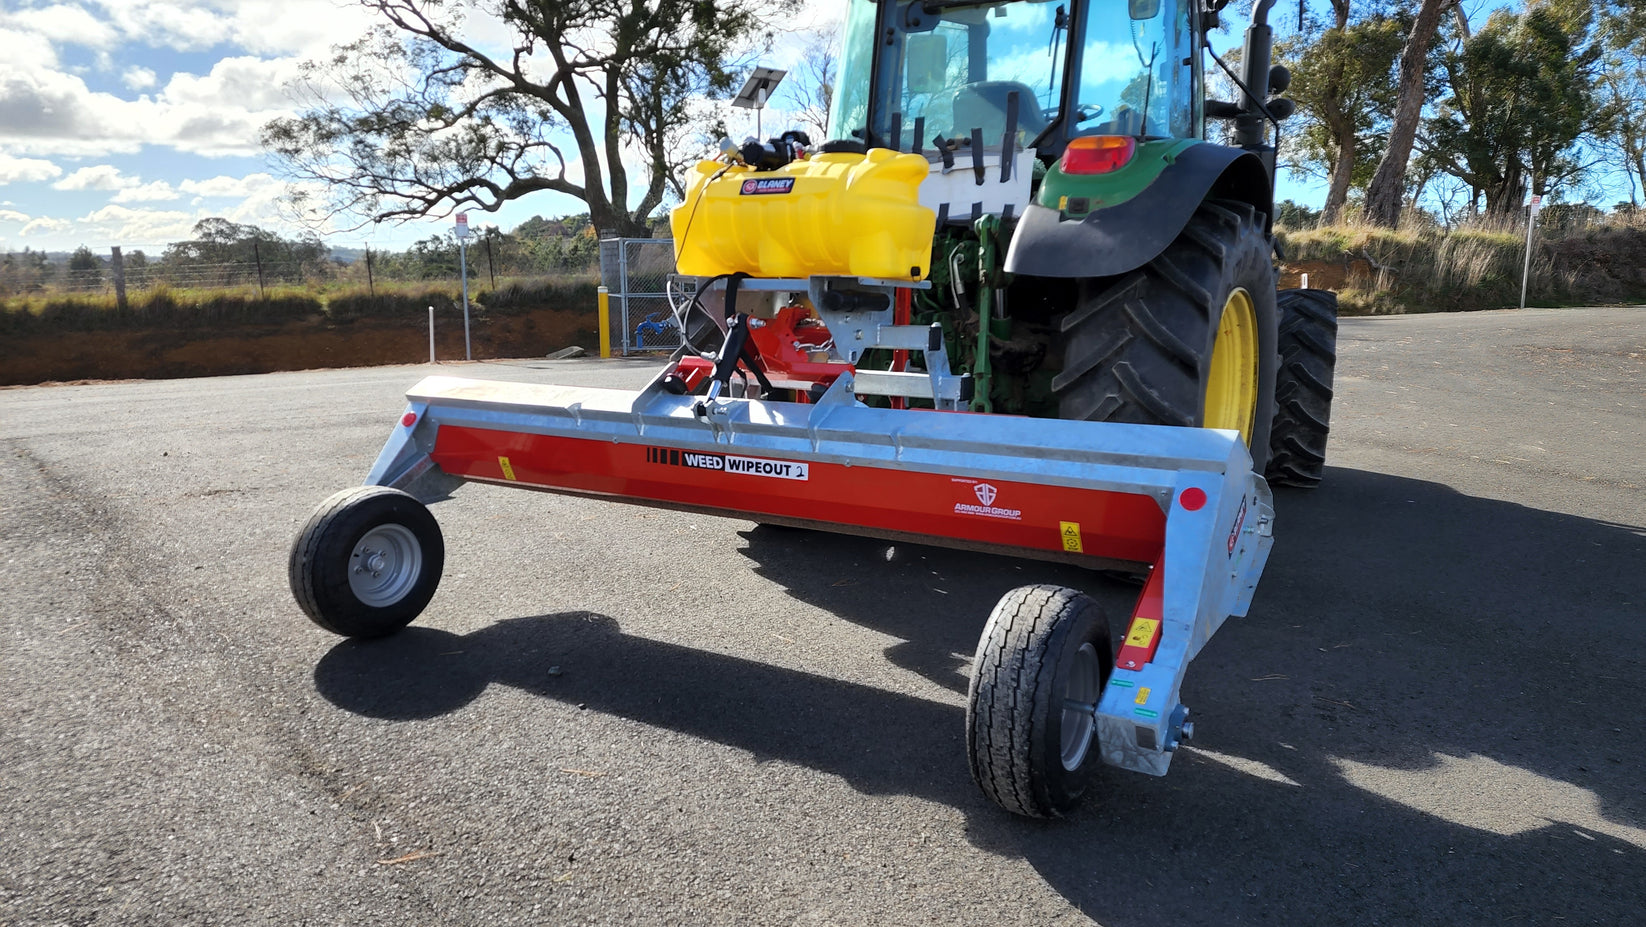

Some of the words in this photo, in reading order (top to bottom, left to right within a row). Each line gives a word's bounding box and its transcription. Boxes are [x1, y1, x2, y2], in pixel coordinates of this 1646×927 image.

[684, 453, 724, 470] WEED
[728, 458, 792, 477] WIPEOUT
[954, 503, 992, 513] ARMOUR
[992, 507, 1021, 517] GROUP
